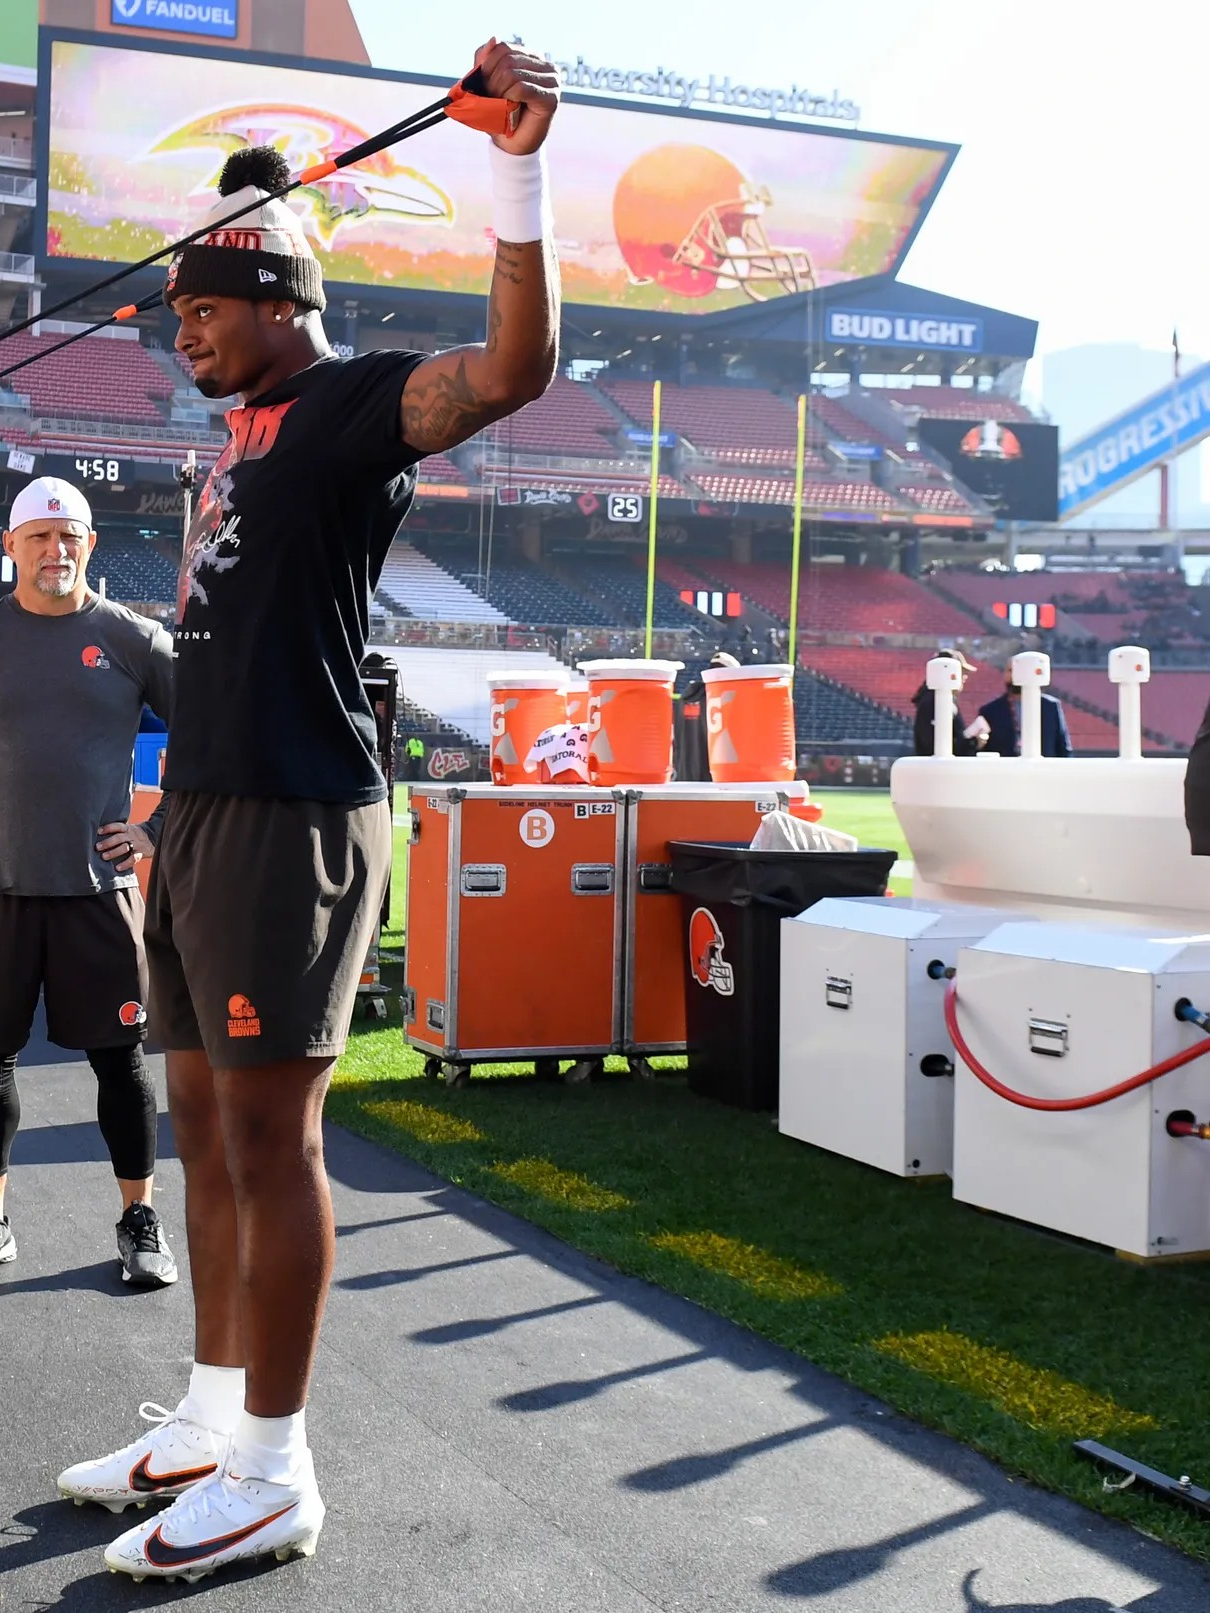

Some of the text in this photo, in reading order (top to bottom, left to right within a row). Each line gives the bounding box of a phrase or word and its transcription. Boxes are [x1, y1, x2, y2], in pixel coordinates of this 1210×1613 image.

[145, 0, 235, 25] FANDUEL
[556, 55, 860, 121] niversity Hospitals
[198, 231, 263, 250] AND
[830, 313, 977, 347] BUD LIGHT
[1059, 378, 1210, 500] ROGRESSI
[75, 459, 119, 482] 4:58
[612, 497, 638, 518] 25
[174, 631, 212, 640] RONG
[708, 697, 723, 734] G
[427, 747, 471, 779] CLE
[577, 805, 587, 817] B
[591, 804, 613, 814] E-22
[757, 802, 777, 812] E-22
[526, 816, 548, 841] B
[227, 1018, 260, 1028] CLEVELAND
[228, 1026, 261, 1037] BROWNS
